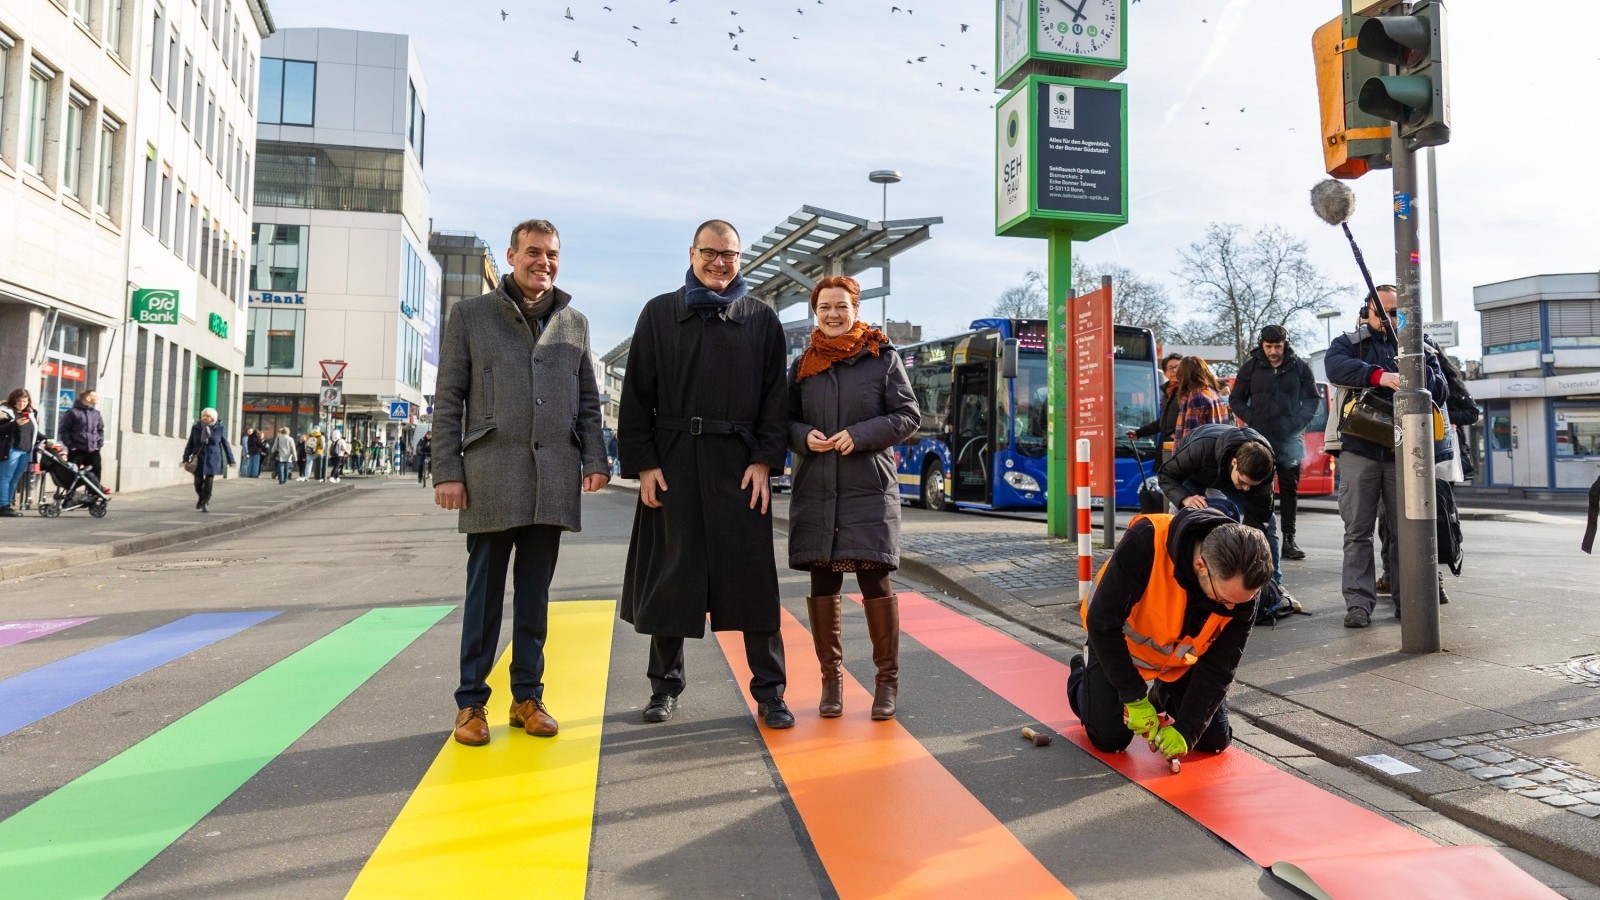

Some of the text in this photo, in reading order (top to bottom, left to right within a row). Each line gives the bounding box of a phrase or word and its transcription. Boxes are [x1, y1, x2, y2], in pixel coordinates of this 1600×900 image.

[1004, 154, 1022, 183] SEH
[1007, 178, 1019, 196] RAU
[140, 310, 174, 322] Bank
